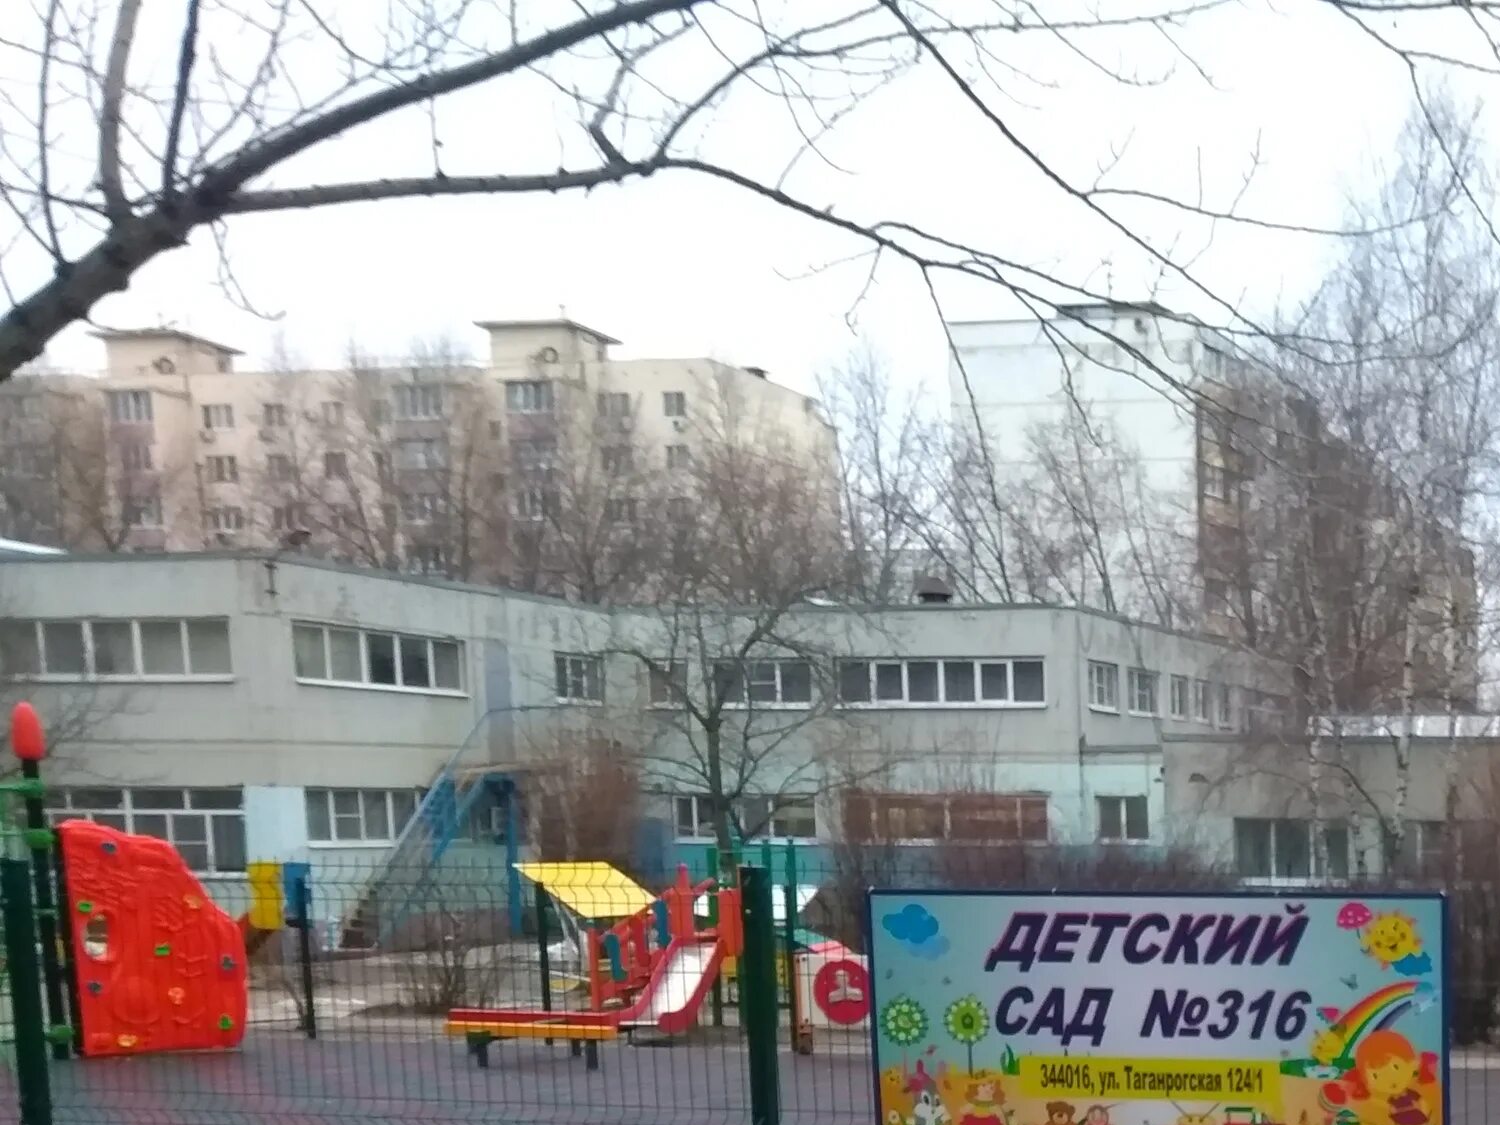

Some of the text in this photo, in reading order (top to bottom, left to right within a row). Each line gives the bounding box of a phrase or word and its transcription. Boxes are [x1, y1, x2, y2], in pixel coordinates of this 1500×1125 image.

[984, 903, 1310, 972] ДЕТСКИЙ
[995, 986, 1312, 1046] САД №316
[1040, 1063, 1263, 1097] 344016, ул. Таганрогская 124/1
